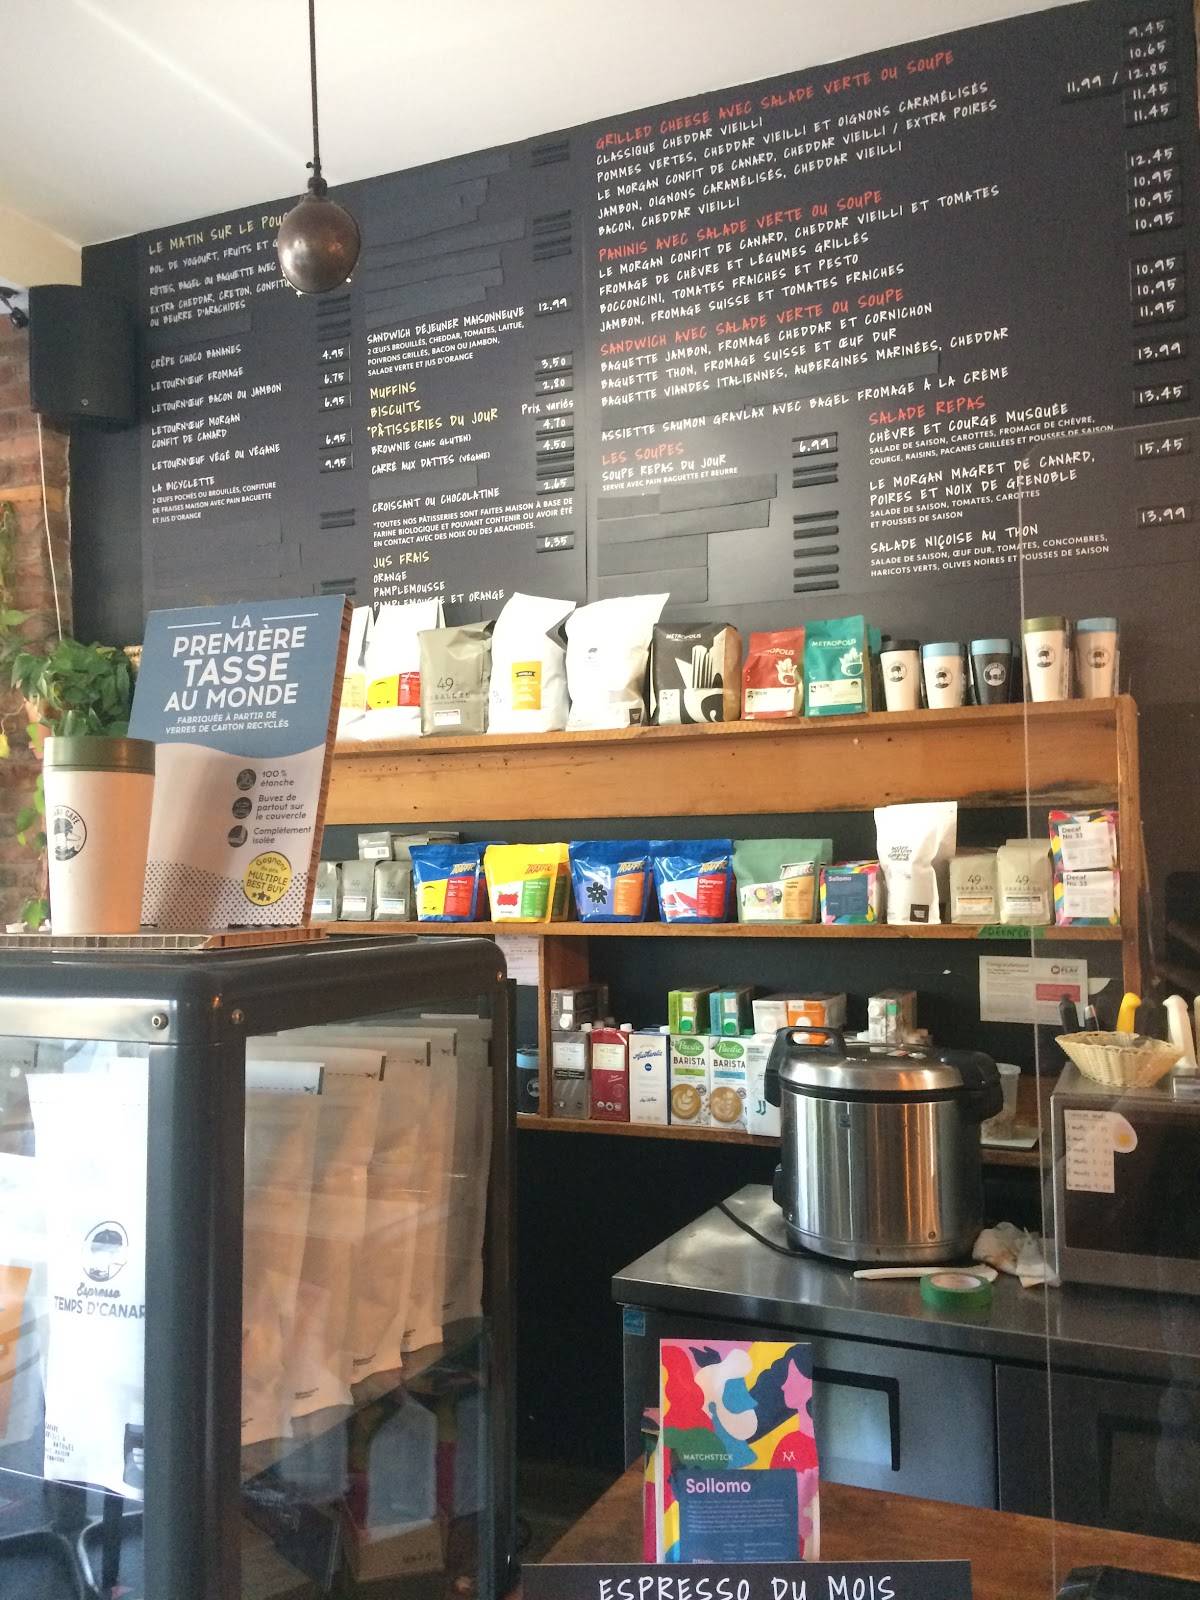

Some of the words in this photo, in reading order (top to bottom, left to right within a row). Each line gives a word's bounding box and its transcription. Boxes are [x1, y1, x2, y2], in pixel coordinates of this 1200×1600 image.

[1130, 41, 1166, 58] 10.65
[595, 126, 651, 150] GRILLED
[659, 111, 710, 133] CHEESE
[718, 101, 751, 119] AVEC
[760, 86, 814, 109] SALADE
[823, 72, 870, 94] VERTE
[880, 67, 897, 80] OU
[907, 51, 953, 73] SOUPE
[596, 141, 655, 165] CLASSIQUE
[662, 127, 712, 149] CHEDDAR
[720, 116, 762, 135] VIEILLI
[598, 219, 634, 236] BACON,
[641, 206, 690, 227] CHEDDAR
[697, 196, 739, 214] VIEILLI
[598, 241, 647, 260] PANINIS
[655, 234, 688, 250] AVEC
[697, 220, 747, 240] SALADE
[756, 207, 801, 228] VERTE
[811, 204, 829, 217] OU
[836, 191, 881, 209] SOUPE
[599, 277, 648, 296] FROMAGE
[655, 272, 669, 285] DE
[676, 262, 719, 281] CHÈVRE
[727, 258, 743, 270] ET
[750, 244, 806, 266] LÉGUMES
[814, 231, 868, 253] GRILLÉS
[599, 292, 664, 314] BOCCONCINI,
[671, 280, 724, 299] TOMATES
[732, 267, 786, 288] FRAICHES
[794, 262, 811, 276] ET
[818, 253, 858, 271] PESTO
[539, 298, 567, 311] 12.99
[366, 328, 410, 344] SANDWICH
[415, 318, 459, 335] DÉJEUNER
[463, 306, 524, 327] MAISONNEUVE
[600, 335, 666, 355] SANDWICH
[674, 326, 706, 342] AVEC
[715, 315, 767, 335] SALADE
[776, 303, 823, 324] VERTE
[831, 300, 849, 314] OU
[857, 288, 904, 308] SOUPE
[150, 355, 175, 369] CRÊPE
[179, 351, 202, 364] CHOCO
[205, 343, 241, 359] BANANES
[1139, 343, 1181, 359] 13.99
[367, 365, 393, 376] SALADE
[394, 362, 414, 372] VERTE
[415, 360, 423, 368] ET
[424, 358, 436, 367] JUS
[437, 352, 473, 364] D'ORANGE
[601, 388, 656, 407] BAGUETTE
[663, 379, 710, 396] VIANDES
[717, 367, 787, 388] ITALIENNES,
[794, 352, 868, 375] AUBERGINES
[876, 339, 942, 360] MARINÉES,
[950, 327, 1008, 348] CHEDDAR
[325, 373, 344, 384] 6.75
[370, 381, 416, 399] MUFFINS
[1139, 387, 1182, 402] 13.45
[370, 399, 421, 418] BISCUITS
[869, 405, 925, 424] SALADE
[935, 396, 985, 414] REPAS
[869, 426, 915, 443] CHÈVRE
[923, 422, 941, 435] ET
[948, 413, 997, 431] COURGE
[1006, 402, 1068, 423] MUSQUÉE
[151, 436, 179, 448] CONFIT
[182, 433, 193, 444] DE
[197, 428, 227, 442] CANARD
[371, 440, 411, 455] BROWNIE
[414, 439, 436, 449] (SANS
[439, 433, 471, 446] GLUTEN)
[800, 438, 828, 452] 6.99
[1140, 438, 1183, 454] 15.45
[602, 451, 627, 465] LES
[634, 443, 684, 460] SOUPES
[601, 467, 634, 482] SOUPE
[640, 462, 674, 476] REPAS
[680, 460, 694, 470] DU
[700, 454, 726, 468] JOUR
[151, 483, 162, 493] LA
[165, 476, 215, 491] BICYCLETTE
[372, 497, 421, 513] CROISSANT
[424, 496, 435, 506] OU
[440, 487, 500, 504] CHOCOLATINE
[870, 507, 900, 517] SALADE
[903, 505, 913, 513] DE
[916, 501, 949, 512] SAISON,
[951, 495, 993, 507] TOMATES,
[995, 489, 1040, 501] CAROTTES
[870, 538, 916, 553] SALADE
[924, 531, 973, 550] NIÇOISE
[981, 529, 996, 541] AU
[1004, 523, 1038, 538] THON
[373, 555, 392, 568] JUS
[399, 550, 429, 565] FRAIS
[373, 570, 407, 583] ORANGE
[373, 580, 445, 597] PAMPLEMOUSSE
[232, 614, 251, 628] LA
[172, 624, 307, 658] PREMIÈRE
[184, 652, 290, 687] TASSE
[437, 677, 454, 691] 49
[164, 690, 198, 712] AU
[206, 683, 298, 710] MONDE
[176, 712, 223, 724] FABRIQUÉE
[226, 712, 232, 721] À
[234, 712, 264, 720] PARTIR
[266, 711, 276, 719] DE
[166, 726, 196, 734] VERRES
[198, 724, 209, 732] DE
[212, 723, 244, 732] CARTON
[247, 720, 289, 730] RECYCLÉS
[260, 778, 294, 787] étanche
[257, 804, 288, 812] partout
[266, 812, 306, 820] couvercle
[253, 836, 275, 844] isolée
[254, 826, 312, 836] Complètement
[246, 878, 266, 890] BEST
[267, 884, 284, 894] BUY
[248, 870, 288, 886] MULTIPLE
[968, 874, 982, 886] 49
[1016, 874, 1030, 886] 49
[674, 1056, 706, 1066] BARISTA
[714, 1060, 746, 1068] BARISTA
[76, 1282, 121, 1298] Espresso
[54, 1296, 82, 1314] TEMPS
[686, 1478, 751, 1494] Sollomo
[599, 1576, 750, 1600] ESPRESSO
[772, 1576, 806, 1600] DU
[828, 1574, 896, 1600] MOIS
